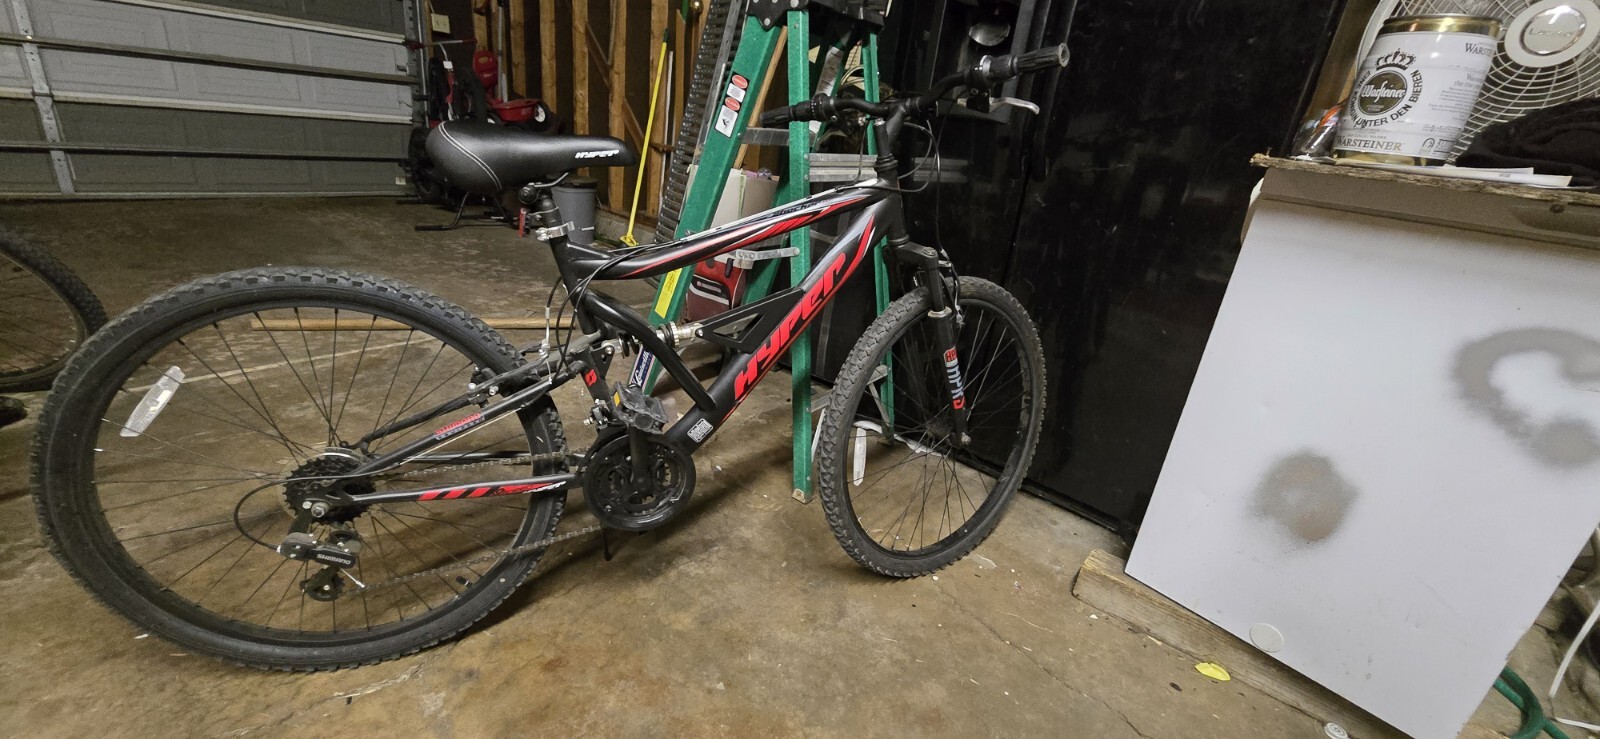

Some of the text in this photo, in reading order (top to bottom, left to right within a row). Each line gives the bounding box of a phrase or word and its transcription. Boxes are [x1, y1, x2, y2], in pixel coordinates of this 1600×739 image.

[1390, 104, 1412, 120] DEN
[1409, 70, 1423, 102] BIEREN
[317, 553, 351, 565] SHIMANO
